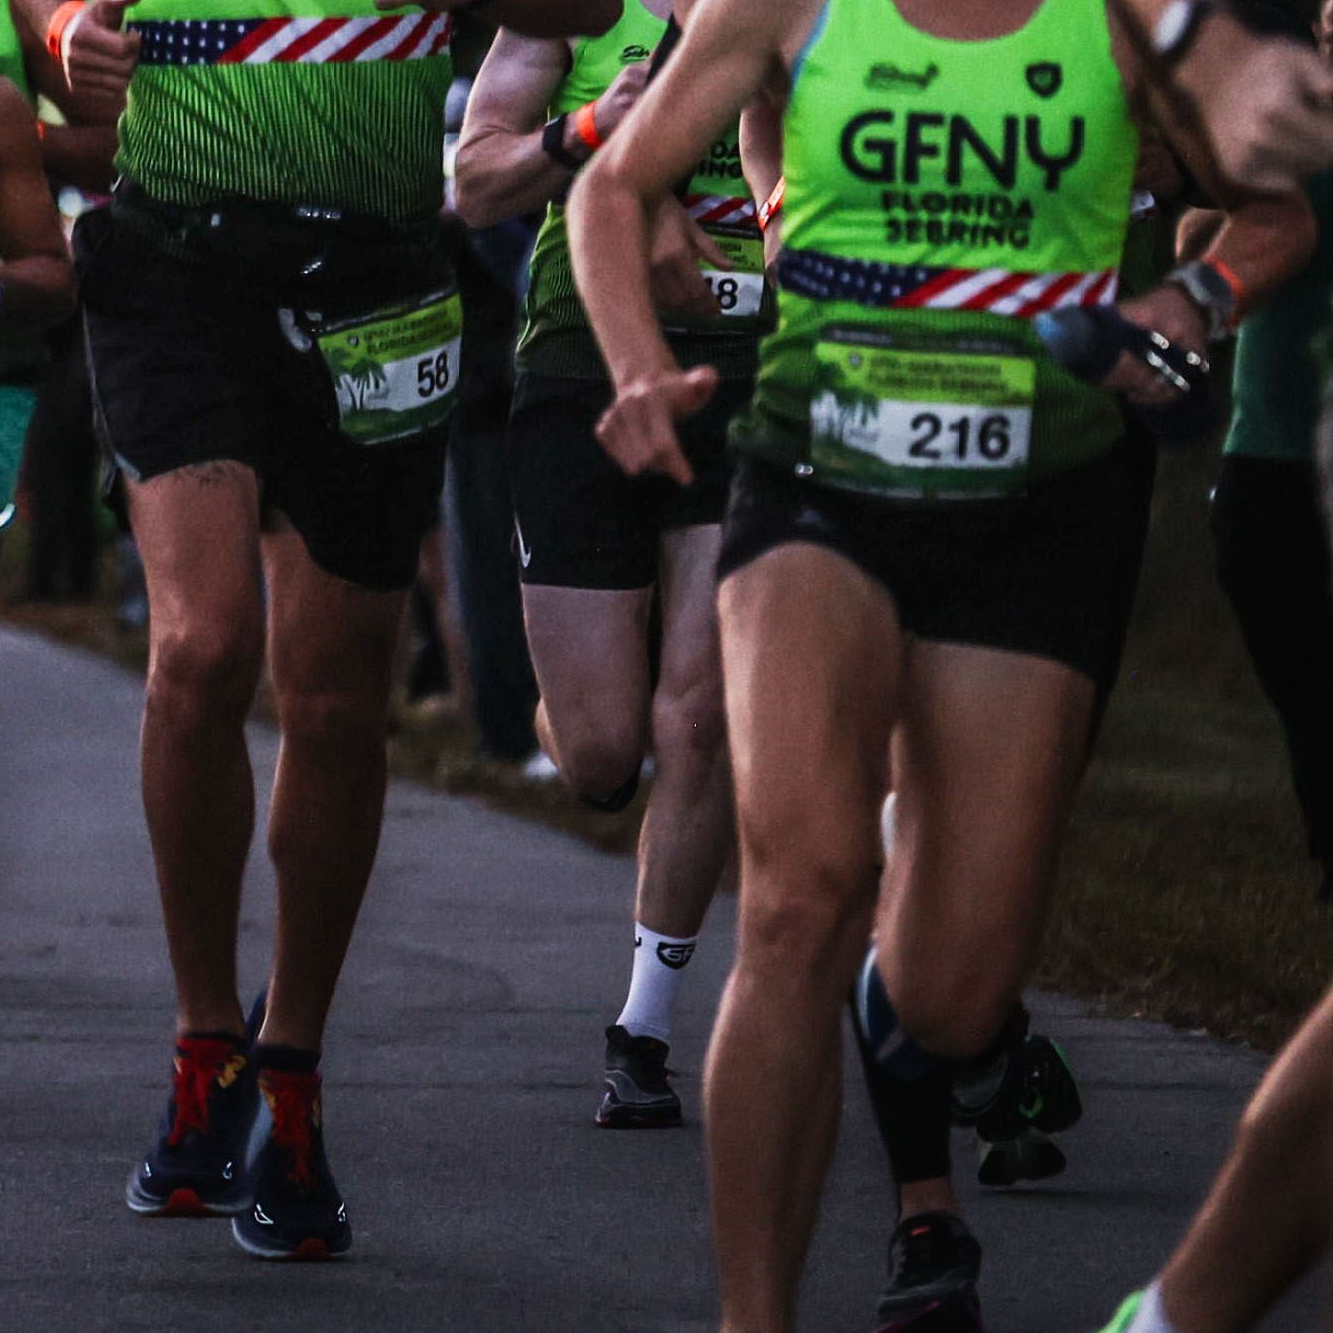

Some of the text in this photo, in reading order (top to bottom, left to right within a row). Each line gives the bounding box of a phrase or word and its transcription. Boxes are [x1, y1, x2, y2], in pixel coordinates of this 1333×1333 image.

[840, 109, 1084, 193] GFNY
[881, 190, 1033, 221] FLORIDA
[417, 351, 448, 398] 58
[908, 412, 1012, 461] 216
